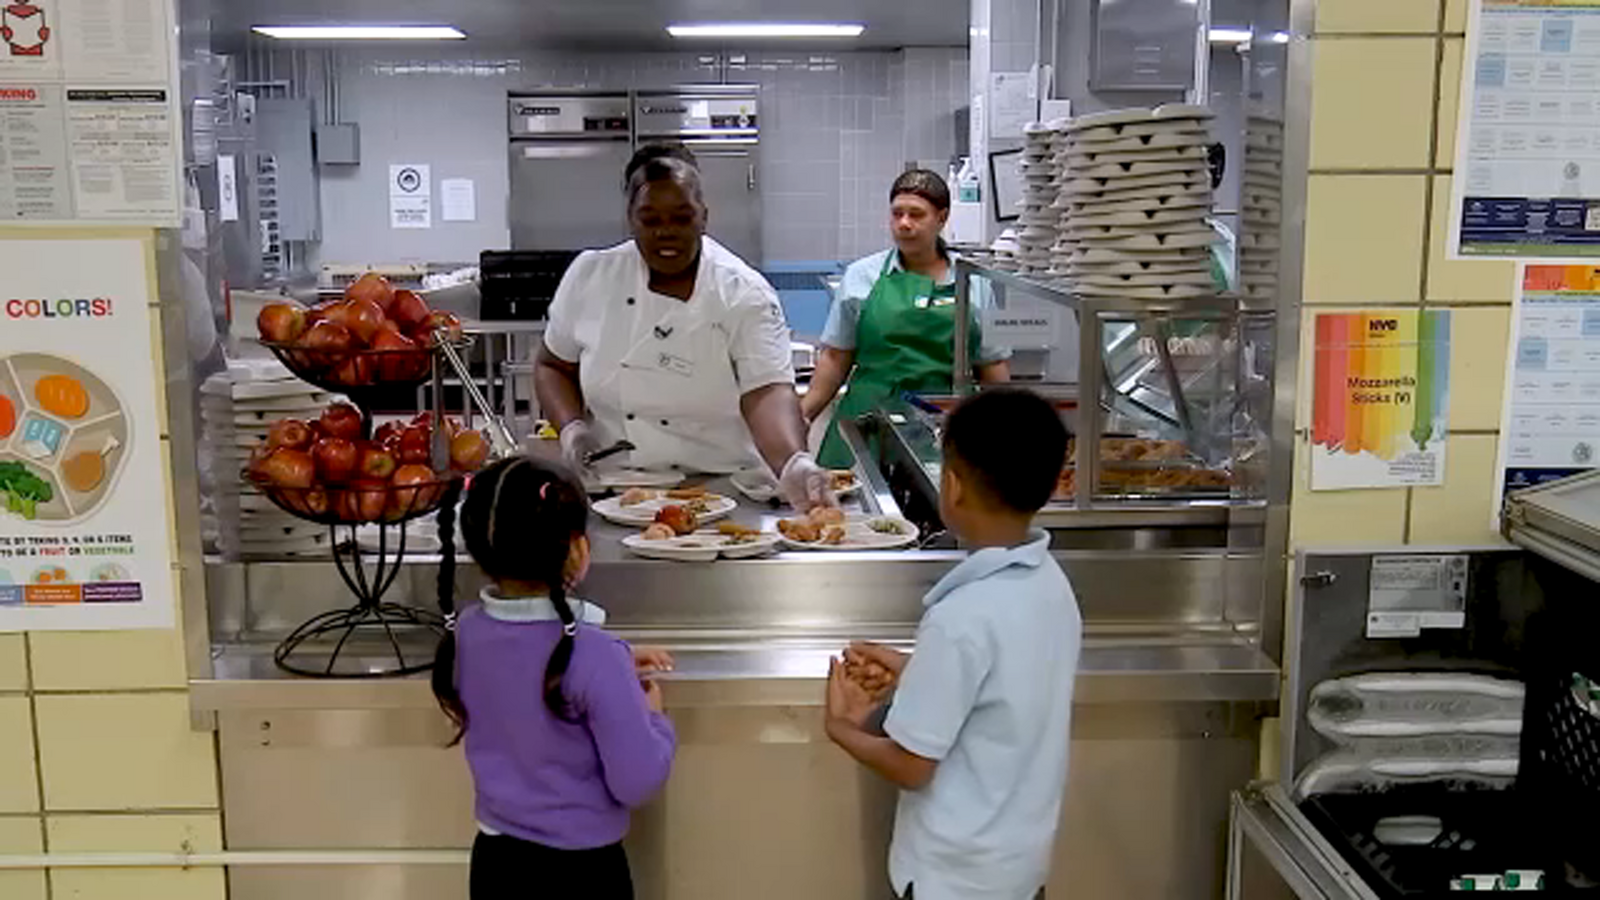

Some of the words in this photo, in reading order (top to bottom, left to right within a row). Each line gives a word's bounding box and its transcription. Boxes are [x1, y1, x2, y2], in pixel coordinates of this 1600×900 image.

[6, 298, 112, 318] COLORS!
[1347, 376, 1416, 389] Mozzarella
[1351, 391, 1391, 405] Sticks
[105, 534, 133, 544] ITEMS
[40, 546, 66, 556] FRUIT
[83, 545, 134, 555] VEGETABLE
